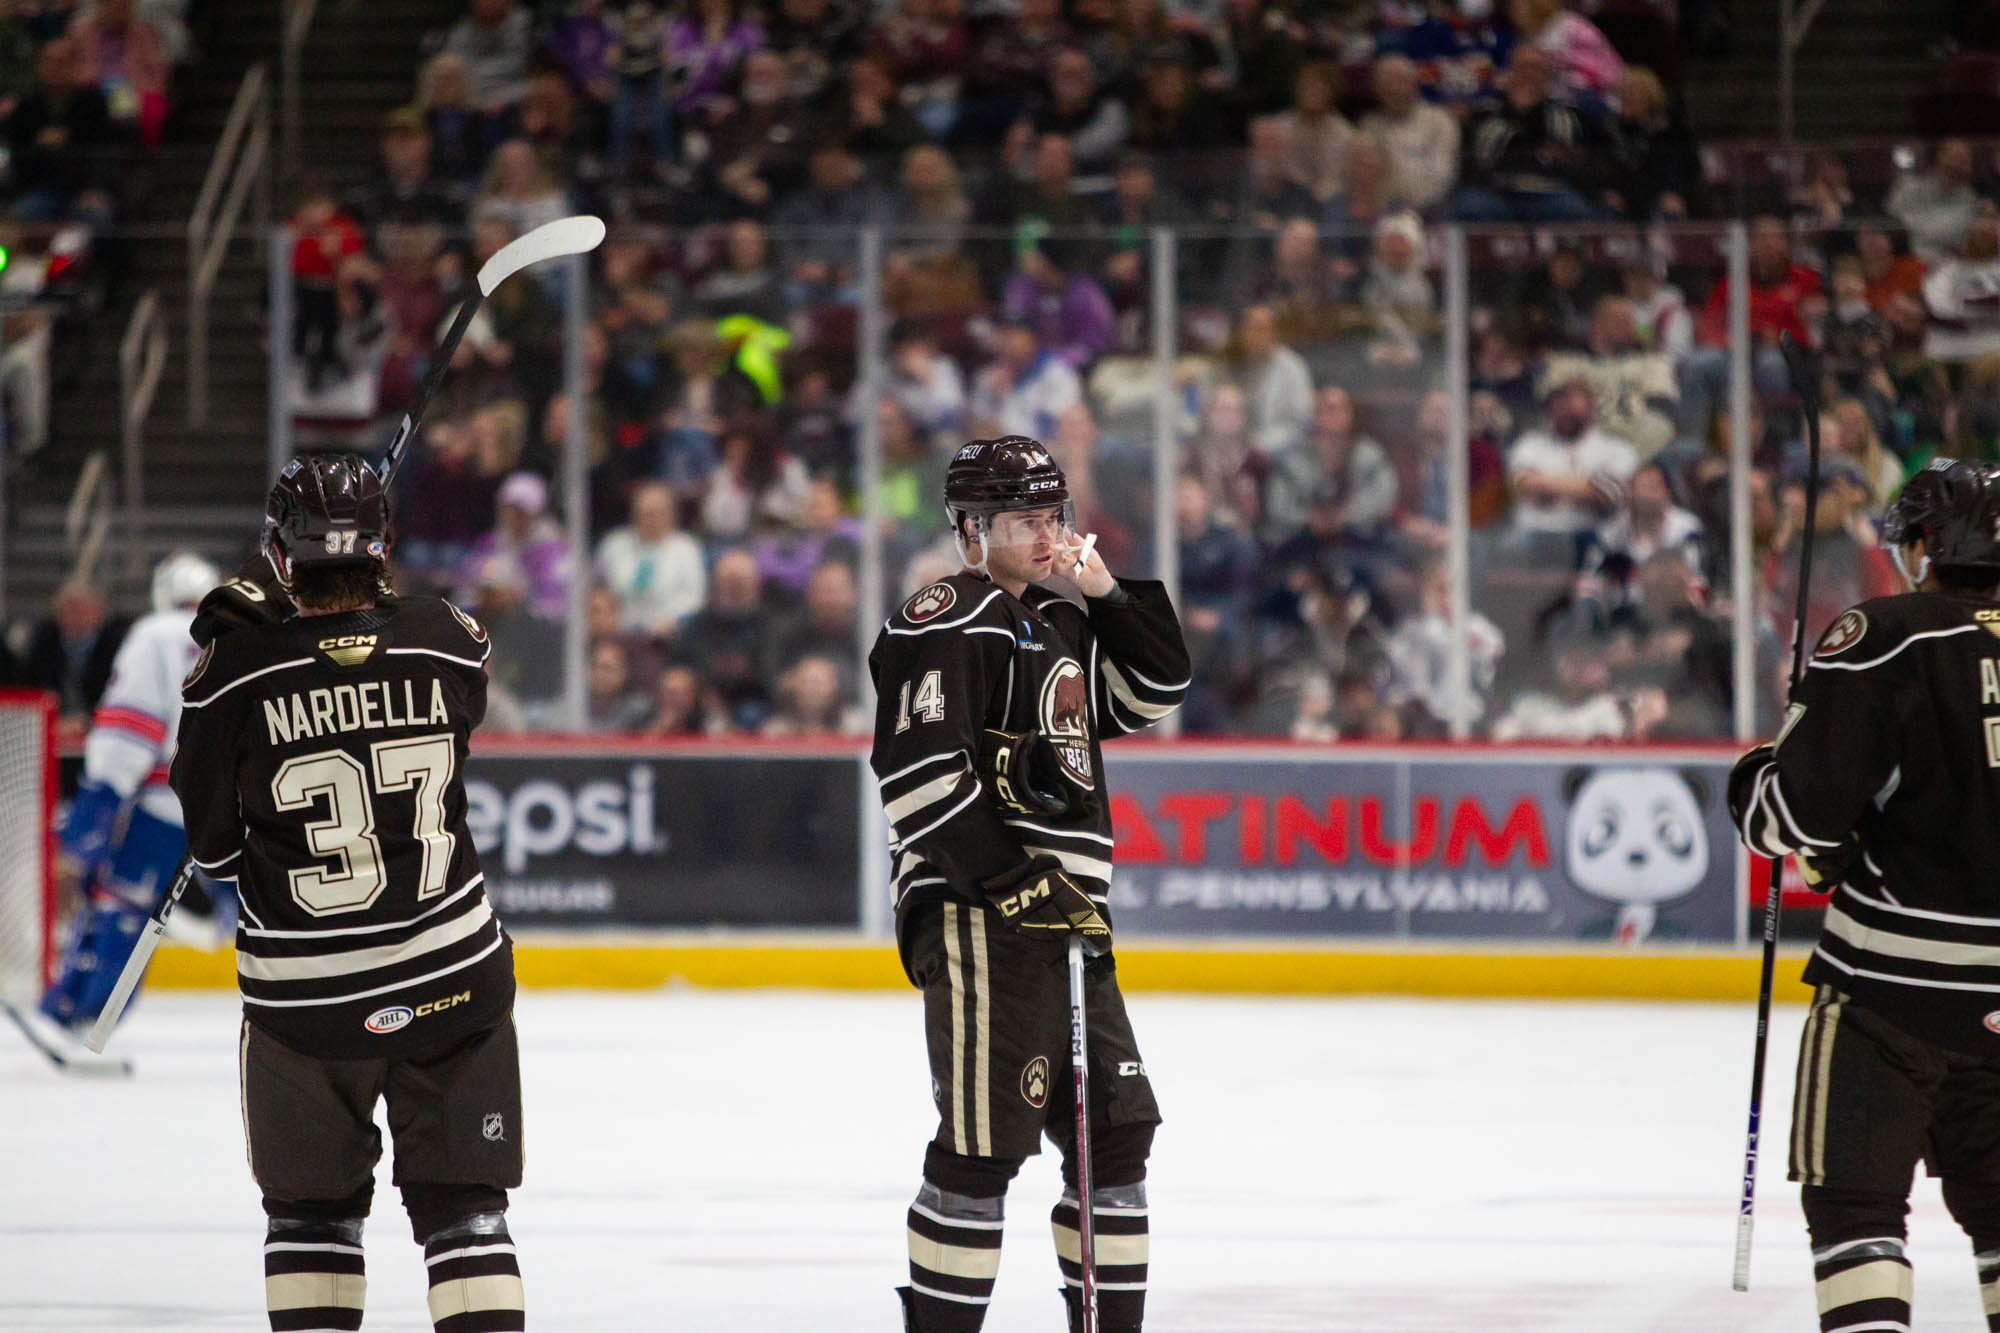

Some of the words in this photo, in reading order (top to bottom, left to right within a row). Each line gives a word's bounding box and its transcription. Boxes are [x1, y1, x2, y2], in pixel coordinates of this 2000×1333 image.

[1020, 450, 1049, 470] 14
[1029, 480, 1059, 491] CCM
[325, 530, 357, 554] 37
[318, 634, 378, 649] CCM
[263, 678, 449, 745] NARDELLA
[895, 670, 944, 735] 14
[271, 733, 456, 917] 37
[1159, 872, 1550, 911] PENNSYLVANIA
[1083, 927, 1109, 936] CCM
[415, 990, 471, 1017] CCM
[1071, 1005, 1082, 1057] CCM
